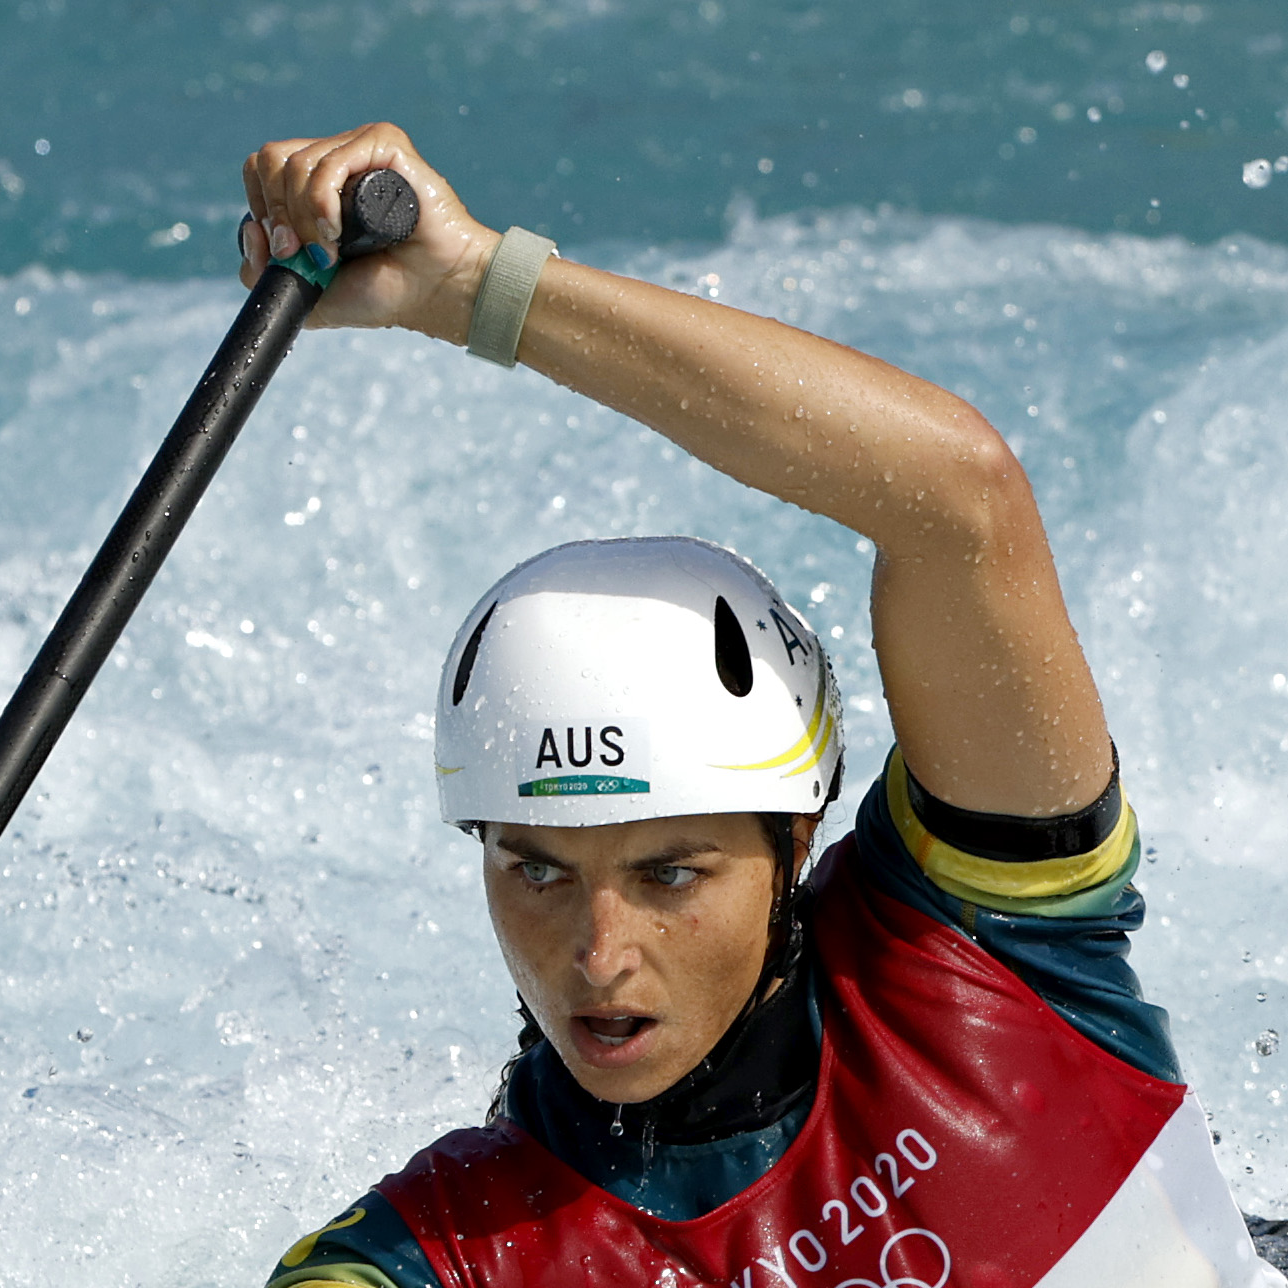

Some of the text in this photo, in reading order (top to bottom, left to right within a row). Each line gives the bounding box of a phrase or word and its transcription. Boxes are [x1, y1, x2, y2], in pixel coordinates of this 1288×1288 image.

[535, 726, 626, 769] AUS
[544, 782, 589, 792] TOKYO 2020
[822, 1128, 938, 1245] 2020
